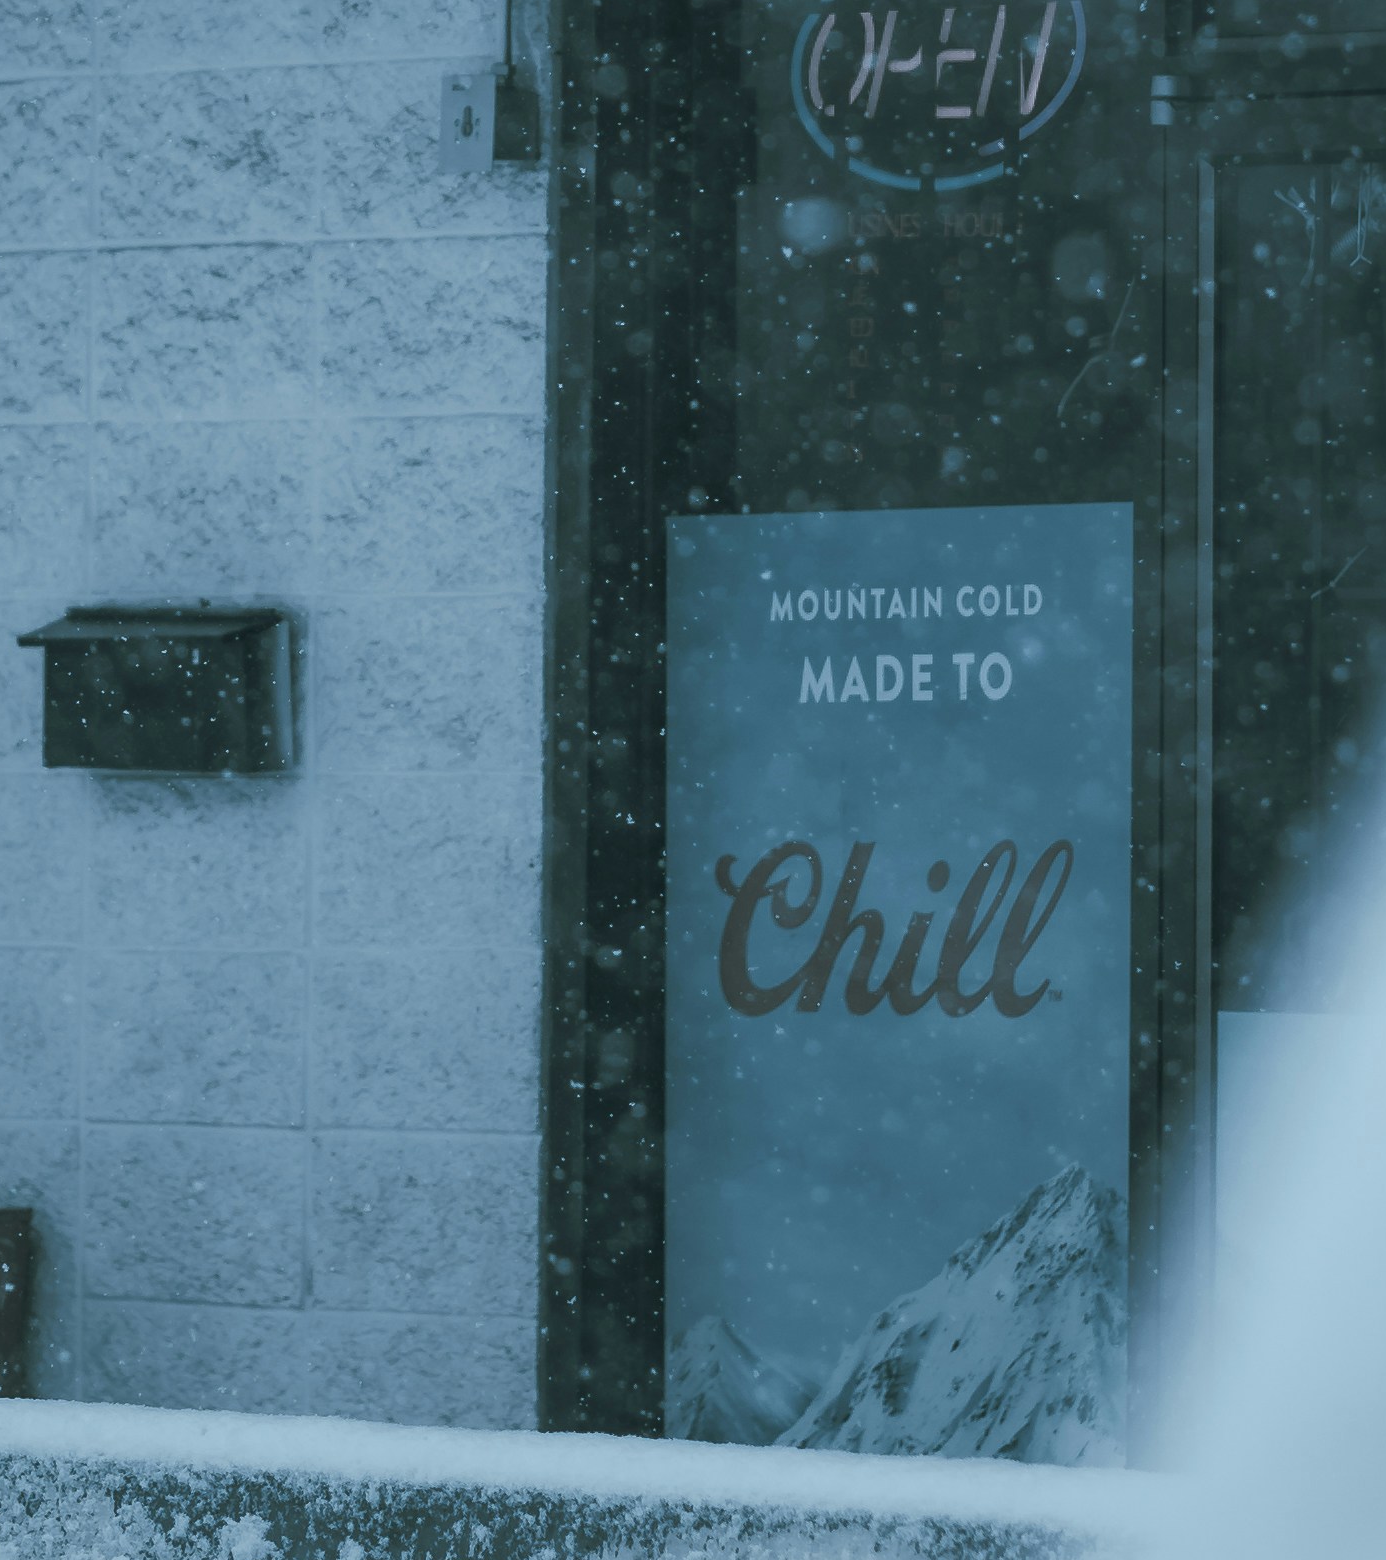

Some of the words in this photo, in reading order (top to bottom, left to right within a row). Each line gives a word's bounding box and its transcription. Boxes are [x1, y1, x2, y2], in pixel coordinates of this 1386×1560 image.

[769, 586, 943, 622] MOUNTAIN
[956, 583, 1043, 618] COLD
[799, 653, 934, 704] MADE
[952, 651, 1013, 701] TO
[714, 839, 1074, 1020] Chill
